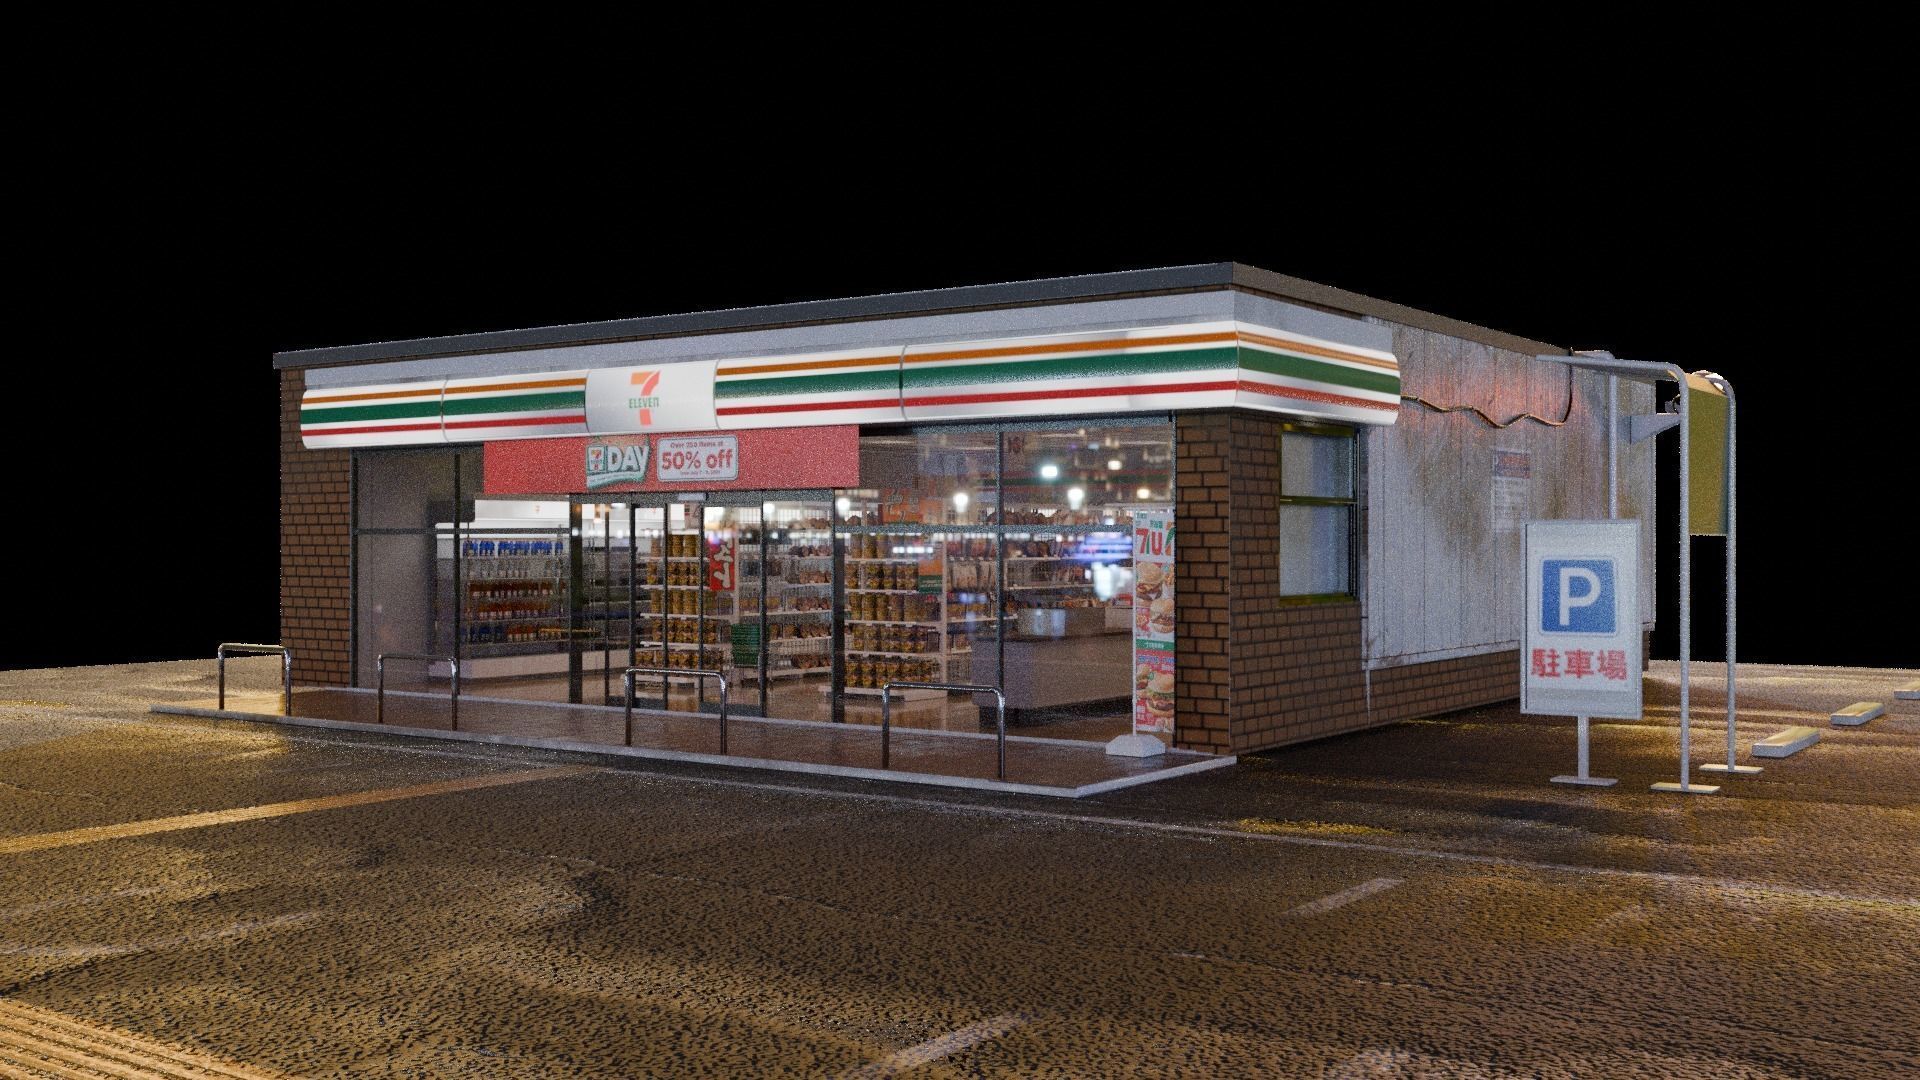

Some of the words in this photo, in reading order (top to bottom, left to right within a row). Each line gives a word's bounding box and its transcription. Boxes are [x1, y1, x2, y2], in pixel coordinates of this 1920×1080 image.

[631, 369, 661, 426] 7
[607, 445, 650, 472] DAY
[662, 450, 702, 470] 50%
[706, 448, 733, 469] off
[1559, 566, 1601, 626] P
[1531, 648, 1627, 680] 駐車場
